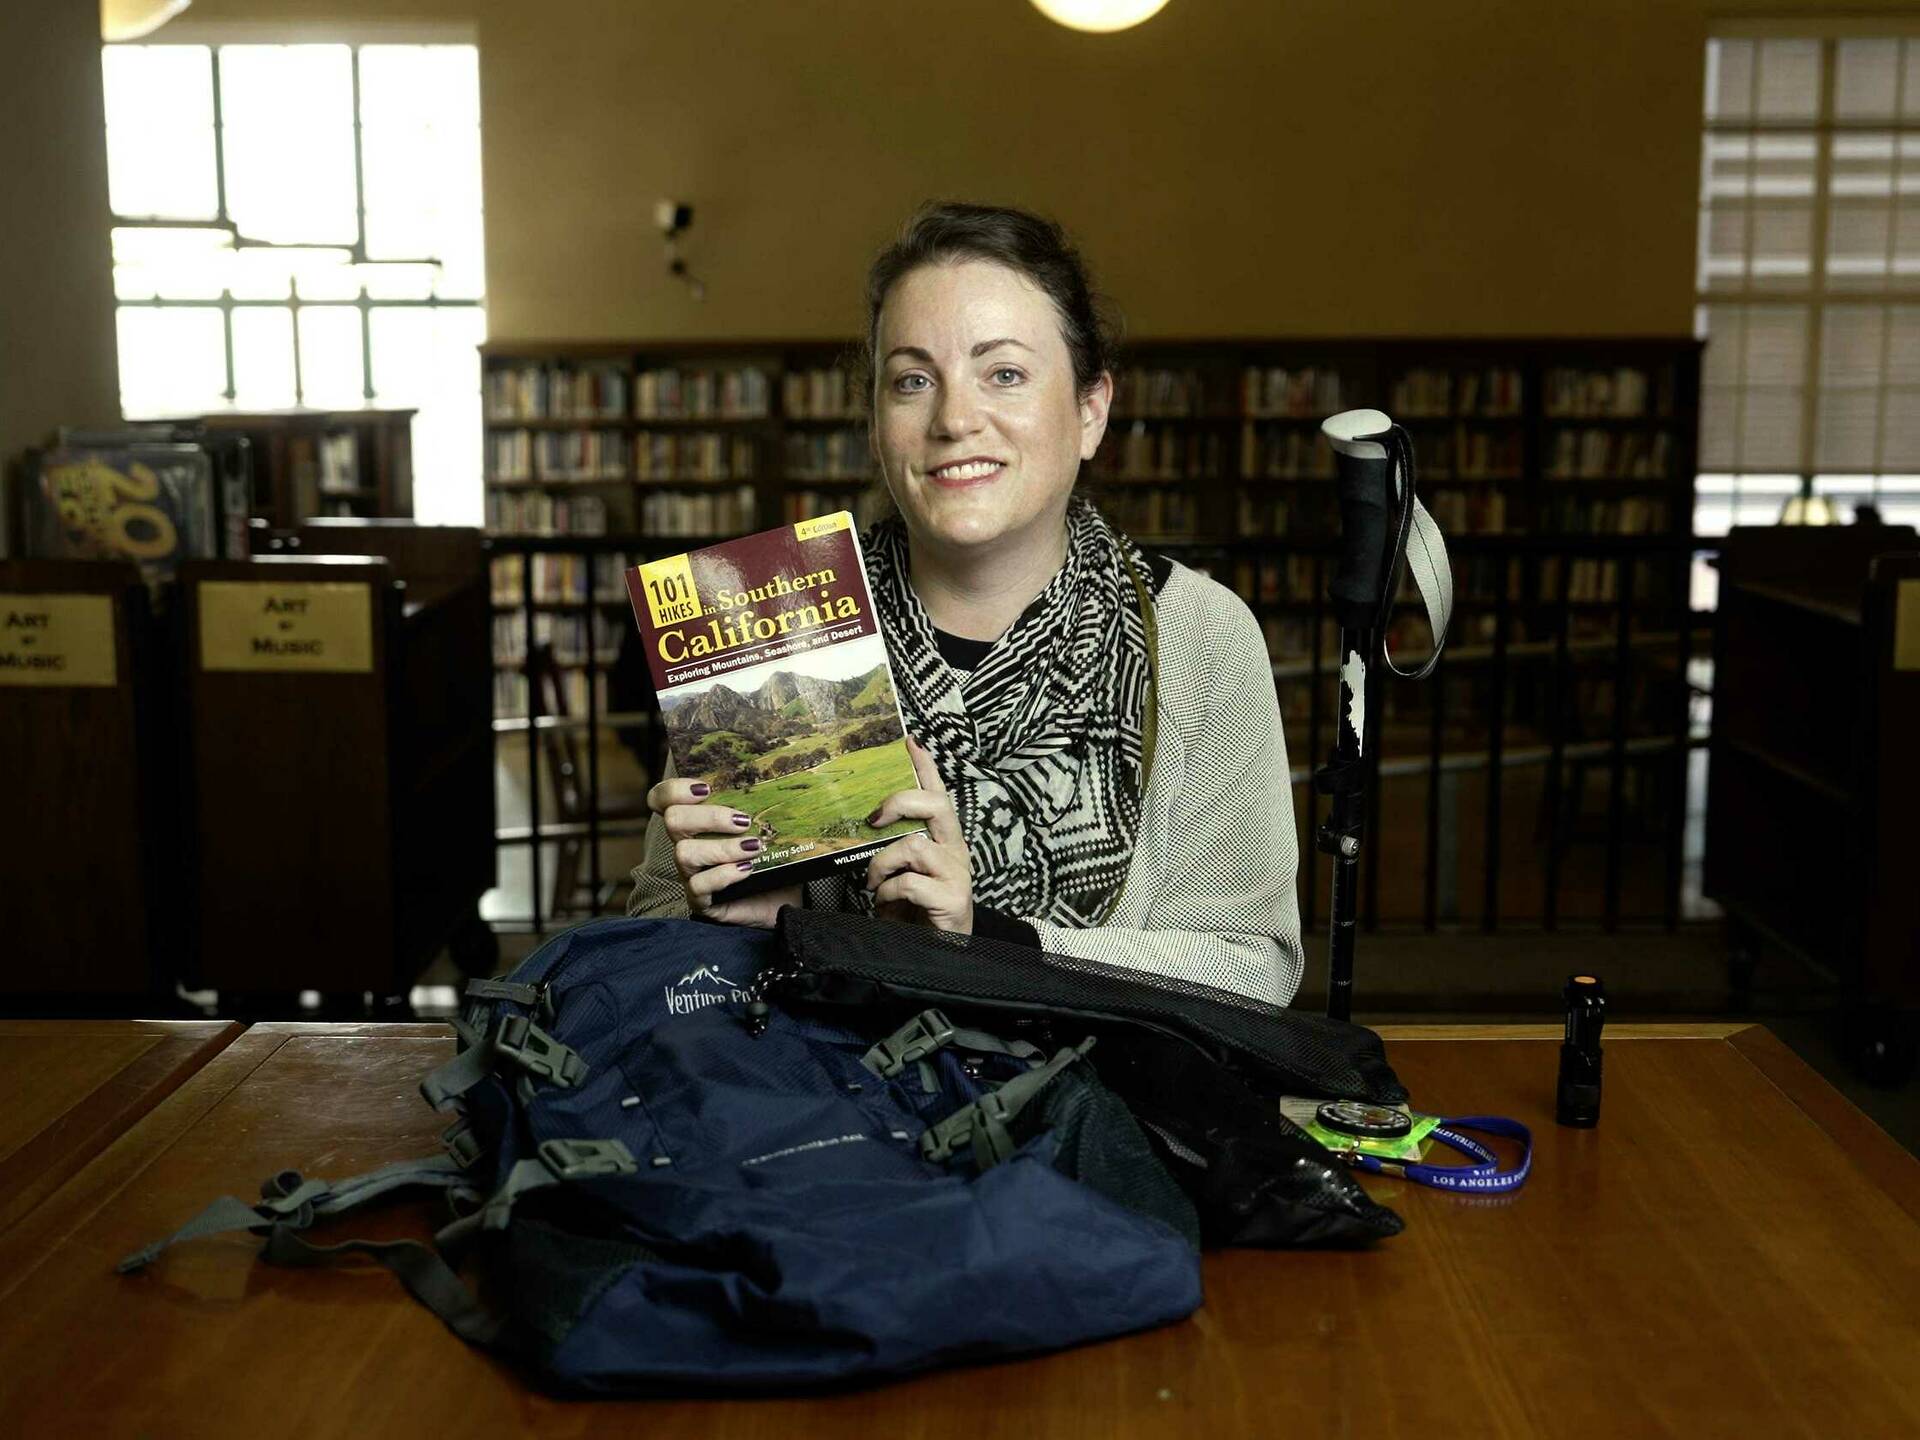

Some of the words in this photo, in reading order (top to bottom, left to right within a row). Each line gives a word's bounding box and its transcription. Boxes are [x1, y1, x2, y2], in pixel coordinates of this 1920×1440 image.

[650, 573, 691, 606] 101
[703, 604, 717, 616] in
[718, 567, 837, 611] Southern
[659, 602, 694, 624] HIKES
[658, 590, 861, 664] California
[251, 637, 324, 657] MUSIC
[667, 666, 711, 684] Exploring
[712, 652, 764, 674] Mountains,
[764, 639, 811, 660] Seashore,
[812, 633, 829, 647] and
[831, 625, 863, 642] Desert
[771, 849, 790, 860] Jerry
[790, 843, 815, 855] Schad
[1432, 1175, 1455, 1186] LOS
[1458, 1175, 1513, 1187] ANGELES
